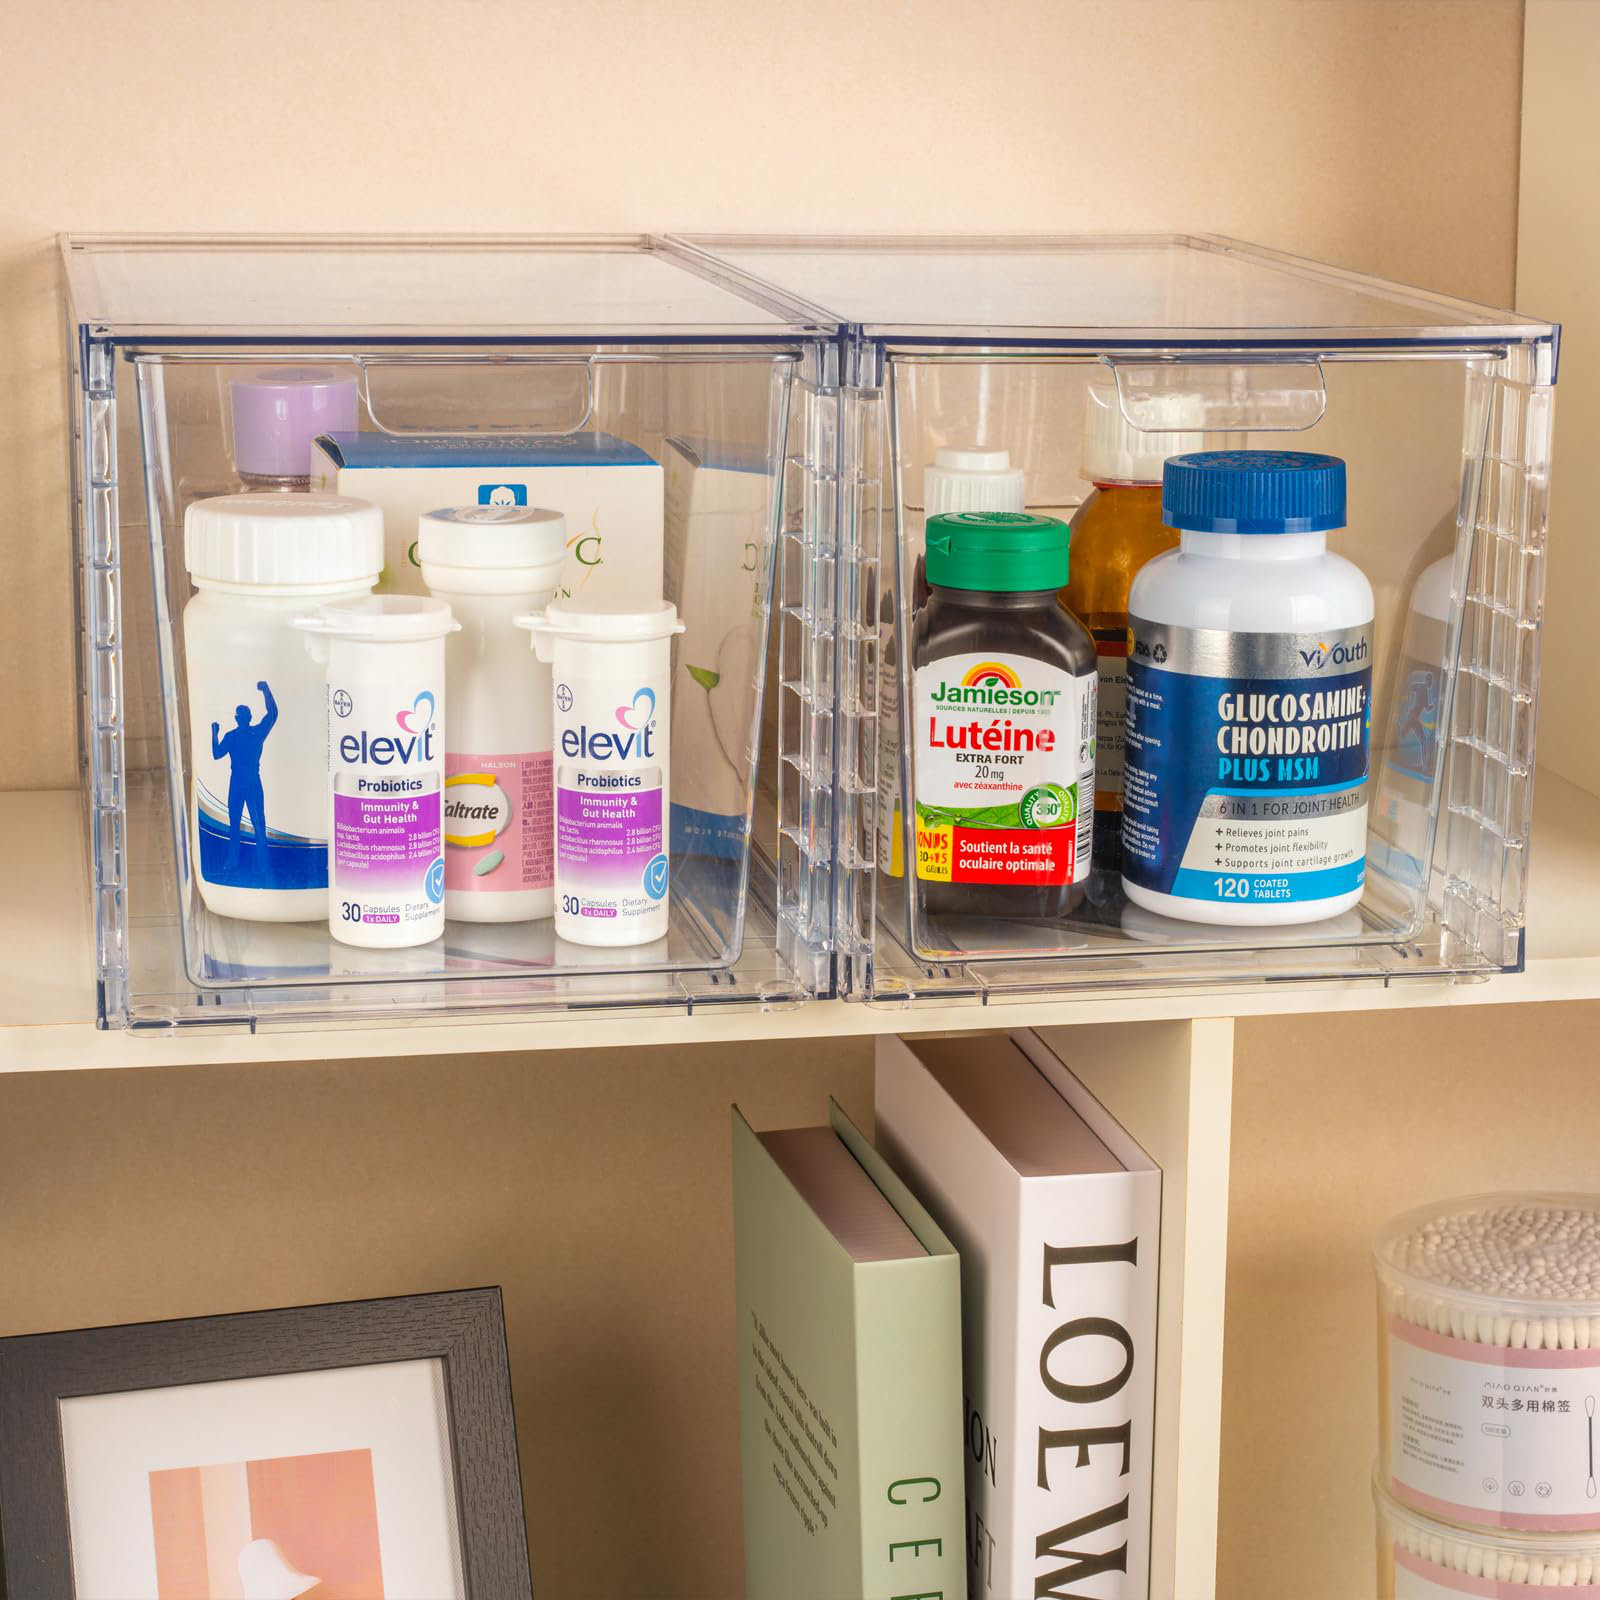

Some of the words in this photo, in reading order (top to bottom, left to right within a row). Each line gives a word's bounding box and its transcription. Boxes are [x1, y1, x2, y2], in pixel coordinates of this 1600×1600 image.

[930, 682, 1054, 706] Jamieson
[936, 704, 966, 712] SOURCES
[968, 706, 1008, 714] NATURELLES
[562, 724, 654, 760] elevit
[930, 716, 1056, 752] Lutéine
[1217, 718, 1361, 755] CHONDROITIN
[340, 727, 434, 765] elevit
[956, 754, 992, 764] EXTRA
[996, 755, 1024, 764] FORT
[975, 765, 989, 778] 20
[990, 770, 1004, 781] mg
[1218, 757, 1270, 782] PLUS
[1278, 756, 1318, 781] MSM
[358, 780, 422, 792] Probiotics
[578, 774, 641, 787] Probiotics
[954, 781, 972, 790] avec
[974, 781, 1024, 791] zéaxanthine
[361, 802, 409, 812] Immunity
[412, 801, 419, 810] &
[580, 796, 628, 808] Immunity
[630, 797, 638, 806] &
[1219, 803, 1226, 814] 6
[1231, 804, 1246, 814] IN
[1252, 804, 1258, 815] 1
[1263, 803, 1289, 816] FOR
[1292, 800, 1326, 814] JOINT
[1329, 792, 1360, 810] HEALTH
[364, 814, 382, 824] Gut
[384, 813, 417, 824] Health
[582, 808, 600, 818] Gut
[602, 810, 636, 818] Health
[1226, 828, 1264, 838] Relieves
[1265, 828, 1286, 840] joint
[1288, 828, 1309, 839] pains
[960, 840, 1008, 856] Soutient
[1010, 842, 1020, 854] la
[1022, 842, 1053, 855] santé
[1226, 844, 1268, 854] Promotes
[1270, 843, 1291, 856] joint
[1292, 840, 1328, 854] flexibility
[960, 858, 1004, 870] oculaire
[1006, 859, 1056, 874] optimale
[1224, 858, 1268, 870] Supports
[1270, 858, 1294, 870] joint
[1296, 854, 1332, 868] cartilage
[1333, 850, 1354, 866] growth
[1214, 878, 1250, 898] 120
[1253, 879, 1288, 888] COATED
[1253, 888, 1291, 898] TABLETS
[342, 902, 361, 922] 30
[363, 904, 400, 914] Capsules
[562, 894, 580, 915] 30
[581, 898, 618, 908] Capsules
[594, 909, 615, 917] DAILY
[1514, 1384, 1540, 1393] QIAN
[1481, 1395, 1572, 1414] 双头多用棉签
